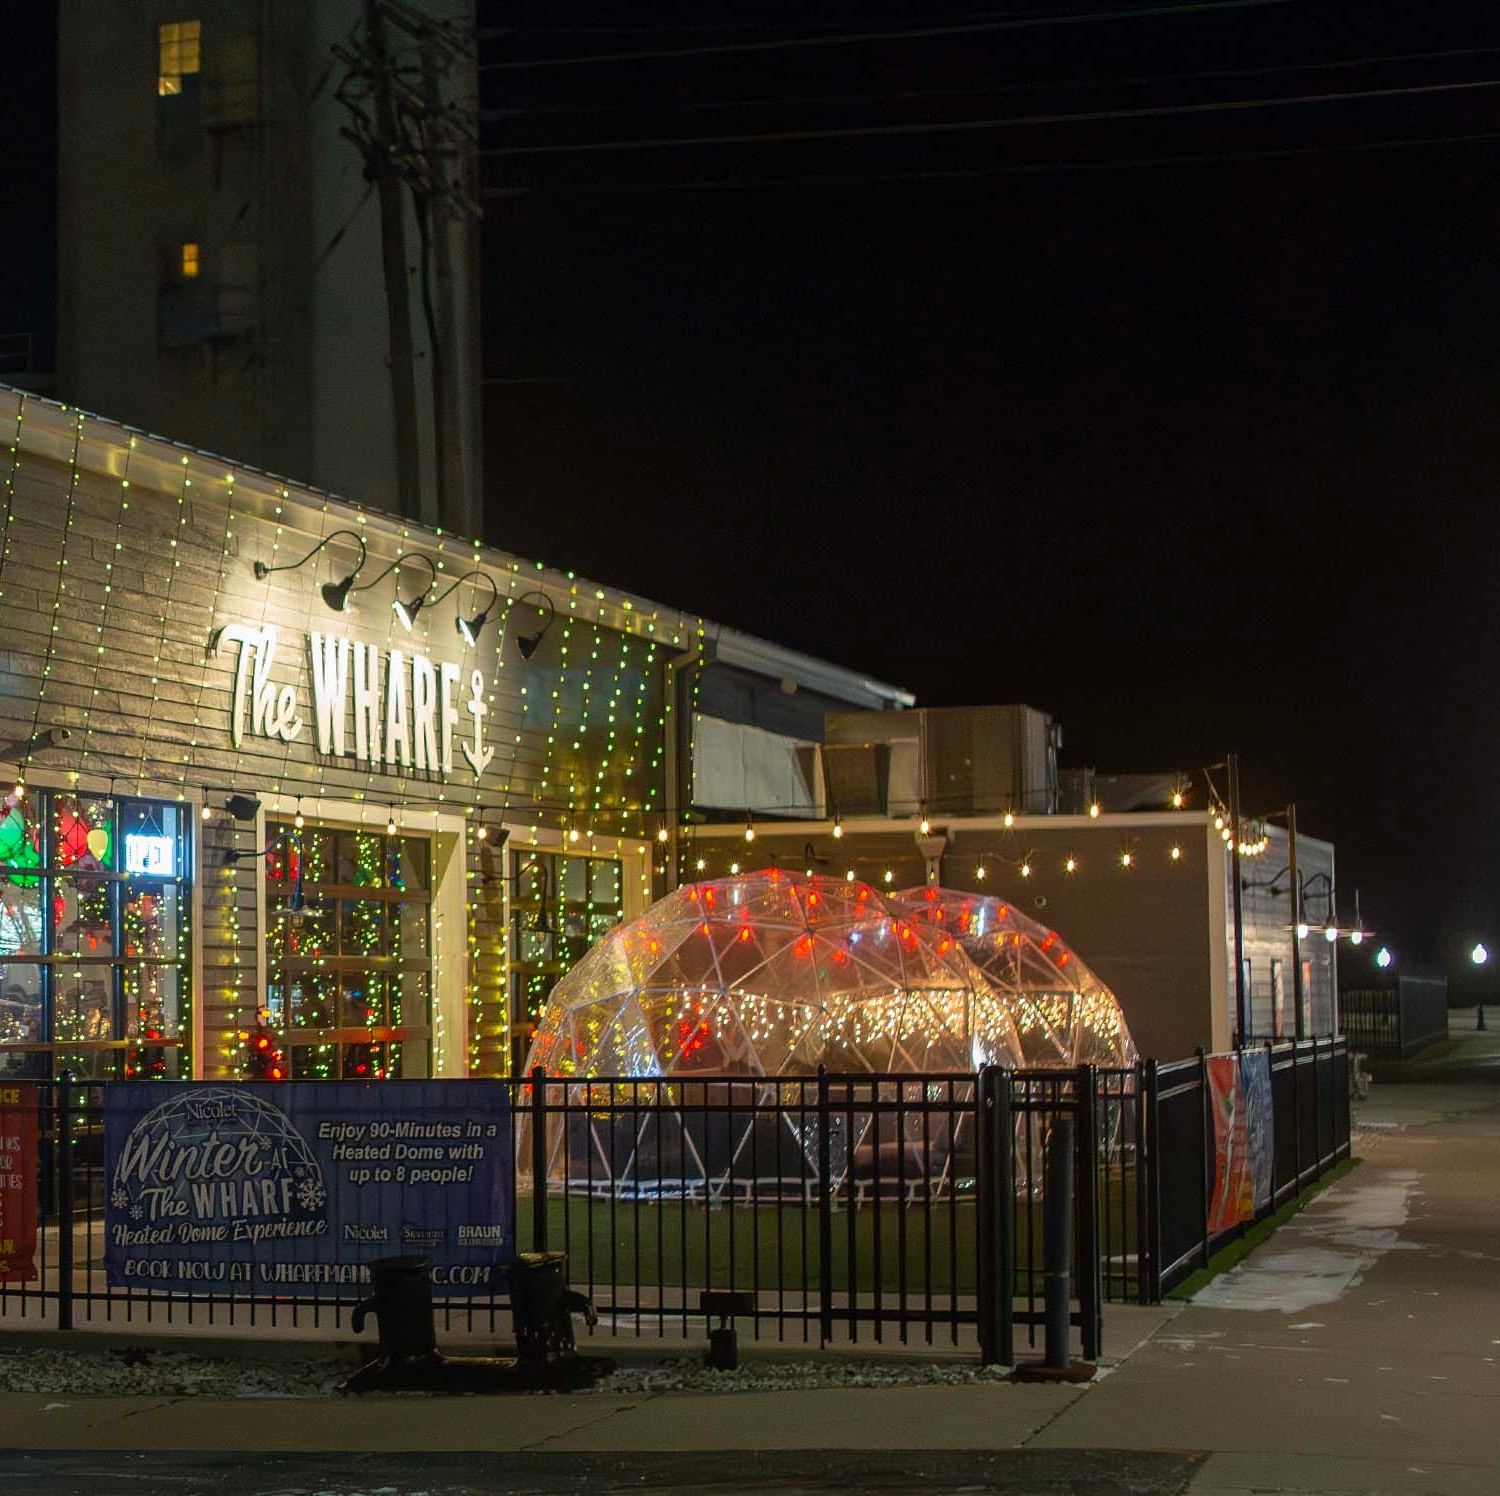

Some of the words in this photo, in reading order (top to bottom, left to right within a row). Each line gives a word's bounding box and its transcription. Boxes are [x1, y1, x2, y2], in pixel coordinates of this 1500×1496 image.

[215, 624, 302, 749] The
[311, 631, 460, 774] WHARF
[188, 1101, 237, 1119] Nicolet
[319, 1122, 365, 1141] Enjoy
[369, 1122, 461, 1138] 90-Minutes
[466, 1121, 481, 1137] in
[486, 1125, 497, 1137] a
[119, 1131, 263, 1184] Winter
[270, 1148, 288, 1169] AT
[332, 1144, 391, 1160] Heated
[395, 1144, 443, 1160] Dome
[449, 1144, 484, 1160] with
[349, 1169, 370, 1185] up
[375, 1167, 391, 1182] to
[396, 1166, 406, 1181] 8
[410, 1165, 474, 1185] people!
[141, 1186, 190, 1221] The
[192, 1177, 294, 1219] WHARF
[112, 1223, 175, 1247] Heated
[178, 1222, 229, 1243] Dome
[232, 1217, 328, 1245] Experience
[344, 1225, 389, 1241] Nicolet
[458, 1225, 501, 1239] BRAUN
[124, 1260, 173, 1280] BOOK
[178, 1261, 225, 1281] NOW
[231, 1263, 254, 1281] AT
